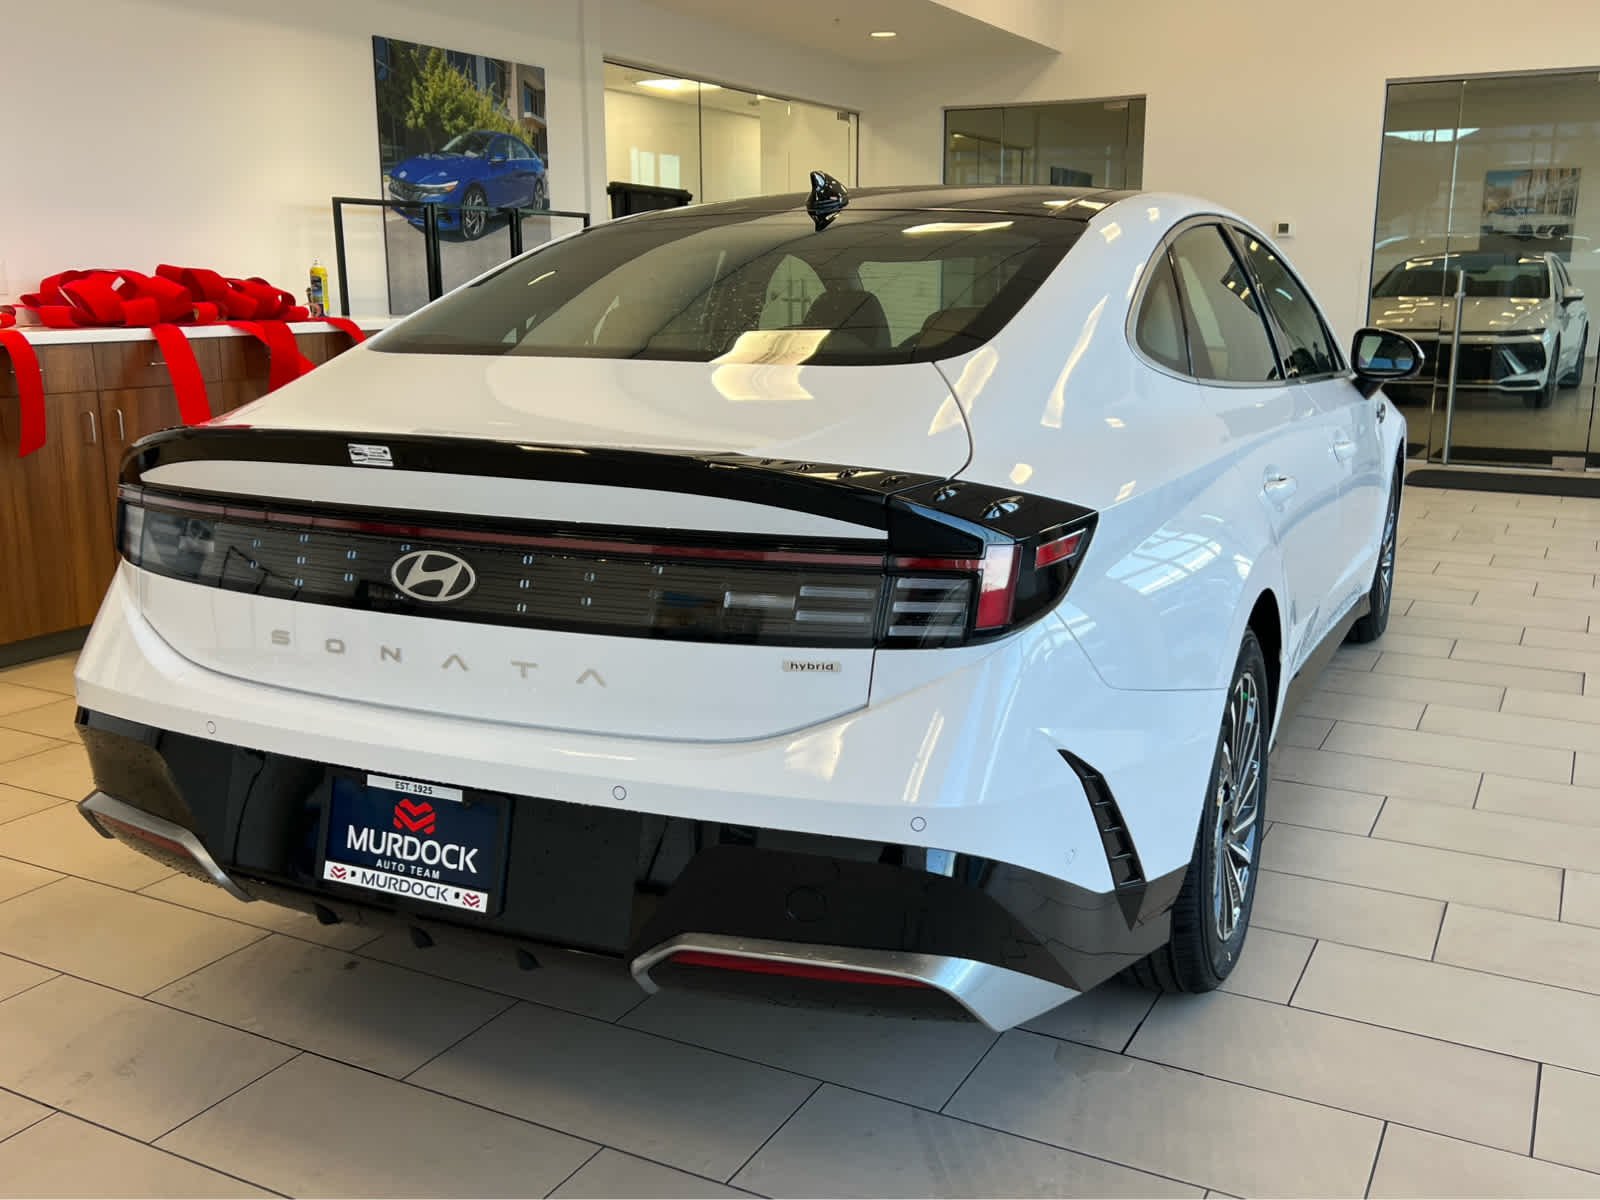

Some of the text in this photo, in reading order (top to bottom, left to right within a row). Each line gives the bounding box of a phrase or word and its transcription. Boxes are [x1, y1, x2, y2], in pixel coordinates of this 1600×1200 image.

[271, 629, 606, 687] SONATA
[790, 661, 834, 671] hybrid
[394, 781, 433, 795] EST. 1925
[346, 824, 478, 873] MURDOCK
[375, 858, 440, 880] AUTO TEAM
[360, 871, 448, 902] MURDOCK
